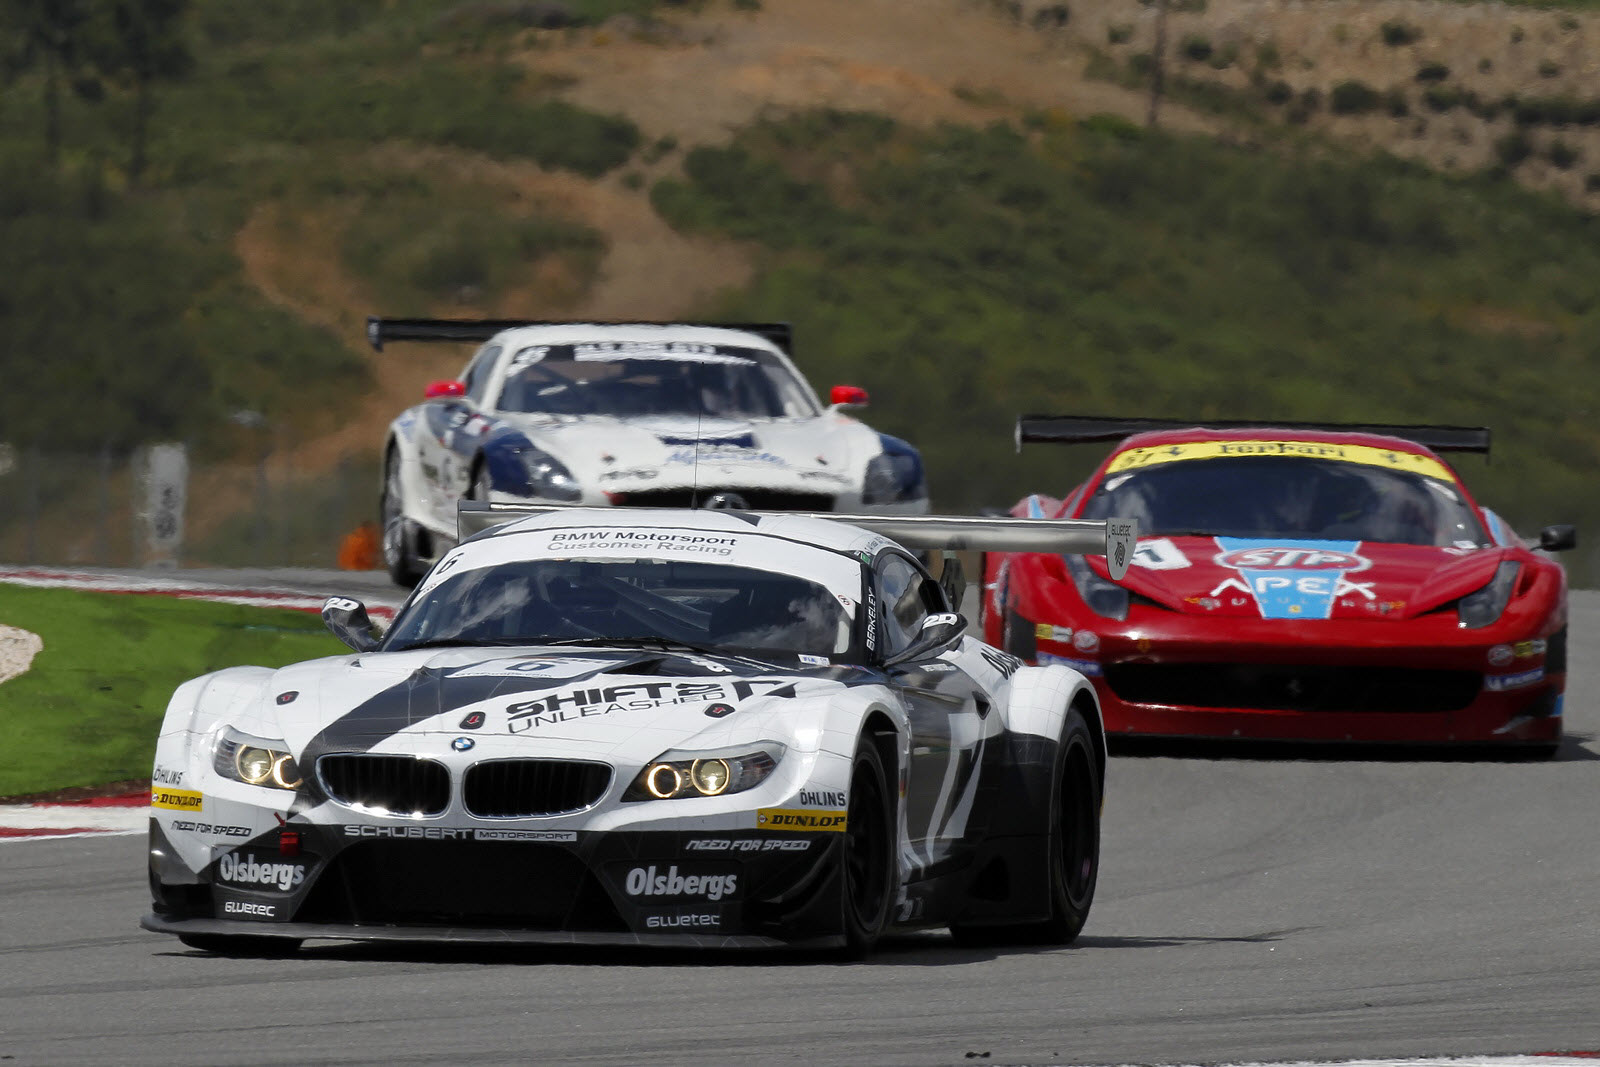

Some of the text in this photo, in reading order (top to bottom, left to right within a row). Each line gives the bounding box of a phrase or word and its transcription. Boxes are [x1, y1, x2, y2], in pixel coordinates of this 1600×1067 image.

[1220, 442, 1346, 457] Ferrari
[551, 531, 738, 546] BMW Motorsport
[547, 541, 733, 556] Customer Racing
[435, 551, 465, 576] 6
[1235, 549, 1348, 567] STP
[1210, 576, 1378, 600] APEX
[866, 588, 877, 652] BERKELEY
[921, 612, 959, 630] 2D
[505, 682, 724, 721] SHIFT 2
[508, 691, 726, 734] UNLEASHED
[152, 764, 183, 786] ÖHLINS
[159, 793, 203, 807] DUNLOP
[799, 788, 847, 807] ÖHLINS
[171, 820, 252, 838] NEED FOR SPEED
[769, 814, 847, 828] DUNLOP
[343, 825, 574, 841] SCHUBERT MOTORSPORT
[685, 839, 812, 851] NEED FOR SPEED
[220, 852, 306, 891] Olsbergs
[625, 865, 738, 901] Olsbergs
